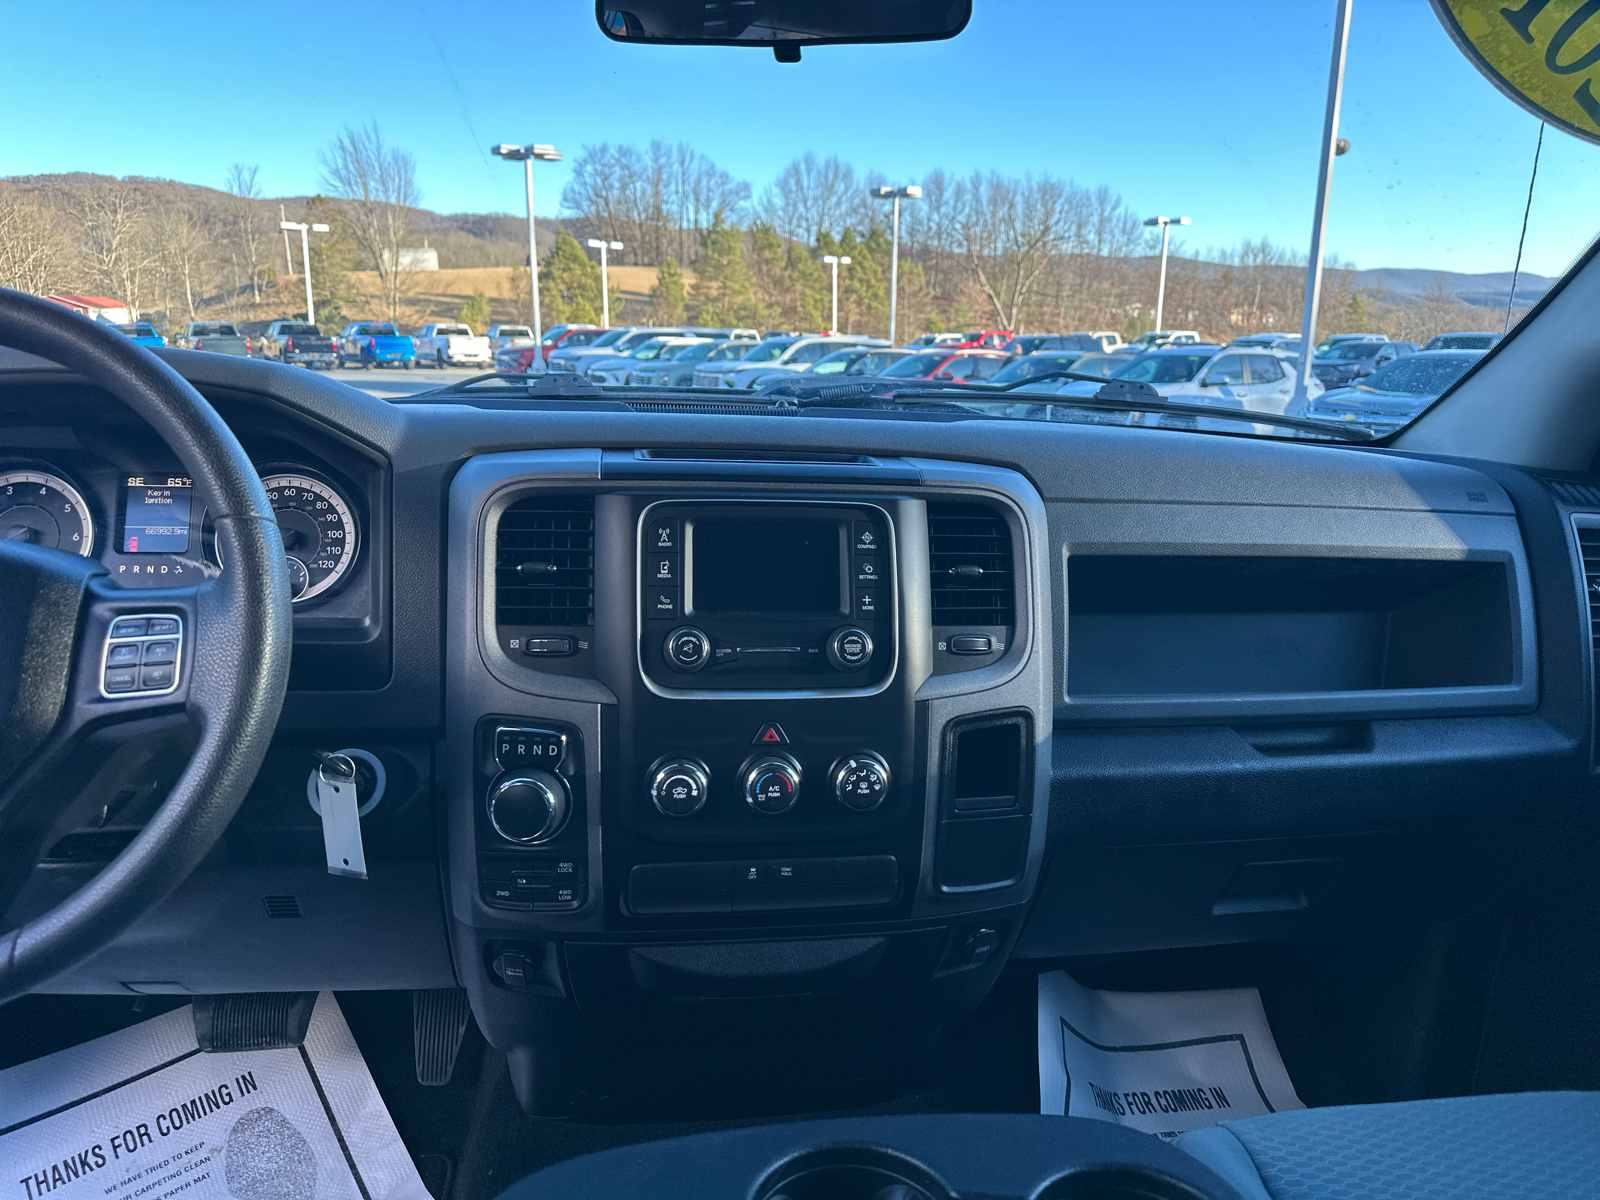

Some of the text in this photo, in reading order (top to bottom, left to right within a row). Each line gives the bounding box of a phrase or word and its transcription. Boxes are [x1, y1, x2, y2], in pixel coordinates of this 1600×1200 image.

[127, 477, 192, 486] SE 65°F
[6, 487, 13, 495] 3
[39, 487, 47, 495] 4
[147, 489, 162, 497] Key
[64, 504, 71, 512] 5
[316, 501, 328, 509] 80
[73, 533, 80, 541] 6
[327, 530, 343, 538] 100
[326, 547, 341, 555] 110
[119, 565, 168, 573] P R N D
[502, 744, 558, 756] P R N D
[1088, 1081, 1231, 1116] THANKS FOR COMING IN
[19, 1071, 259, 1200] THANKS FOR COMING IN
[104, 1141, 205, 1195] WE HAVE TRIED TO KEEP
[134, 1169, 183, 1197] CARPETING
[184, 1155, 211, 1173] CLEAN
[163, 1171, 211, 1200] PAPER MAT
